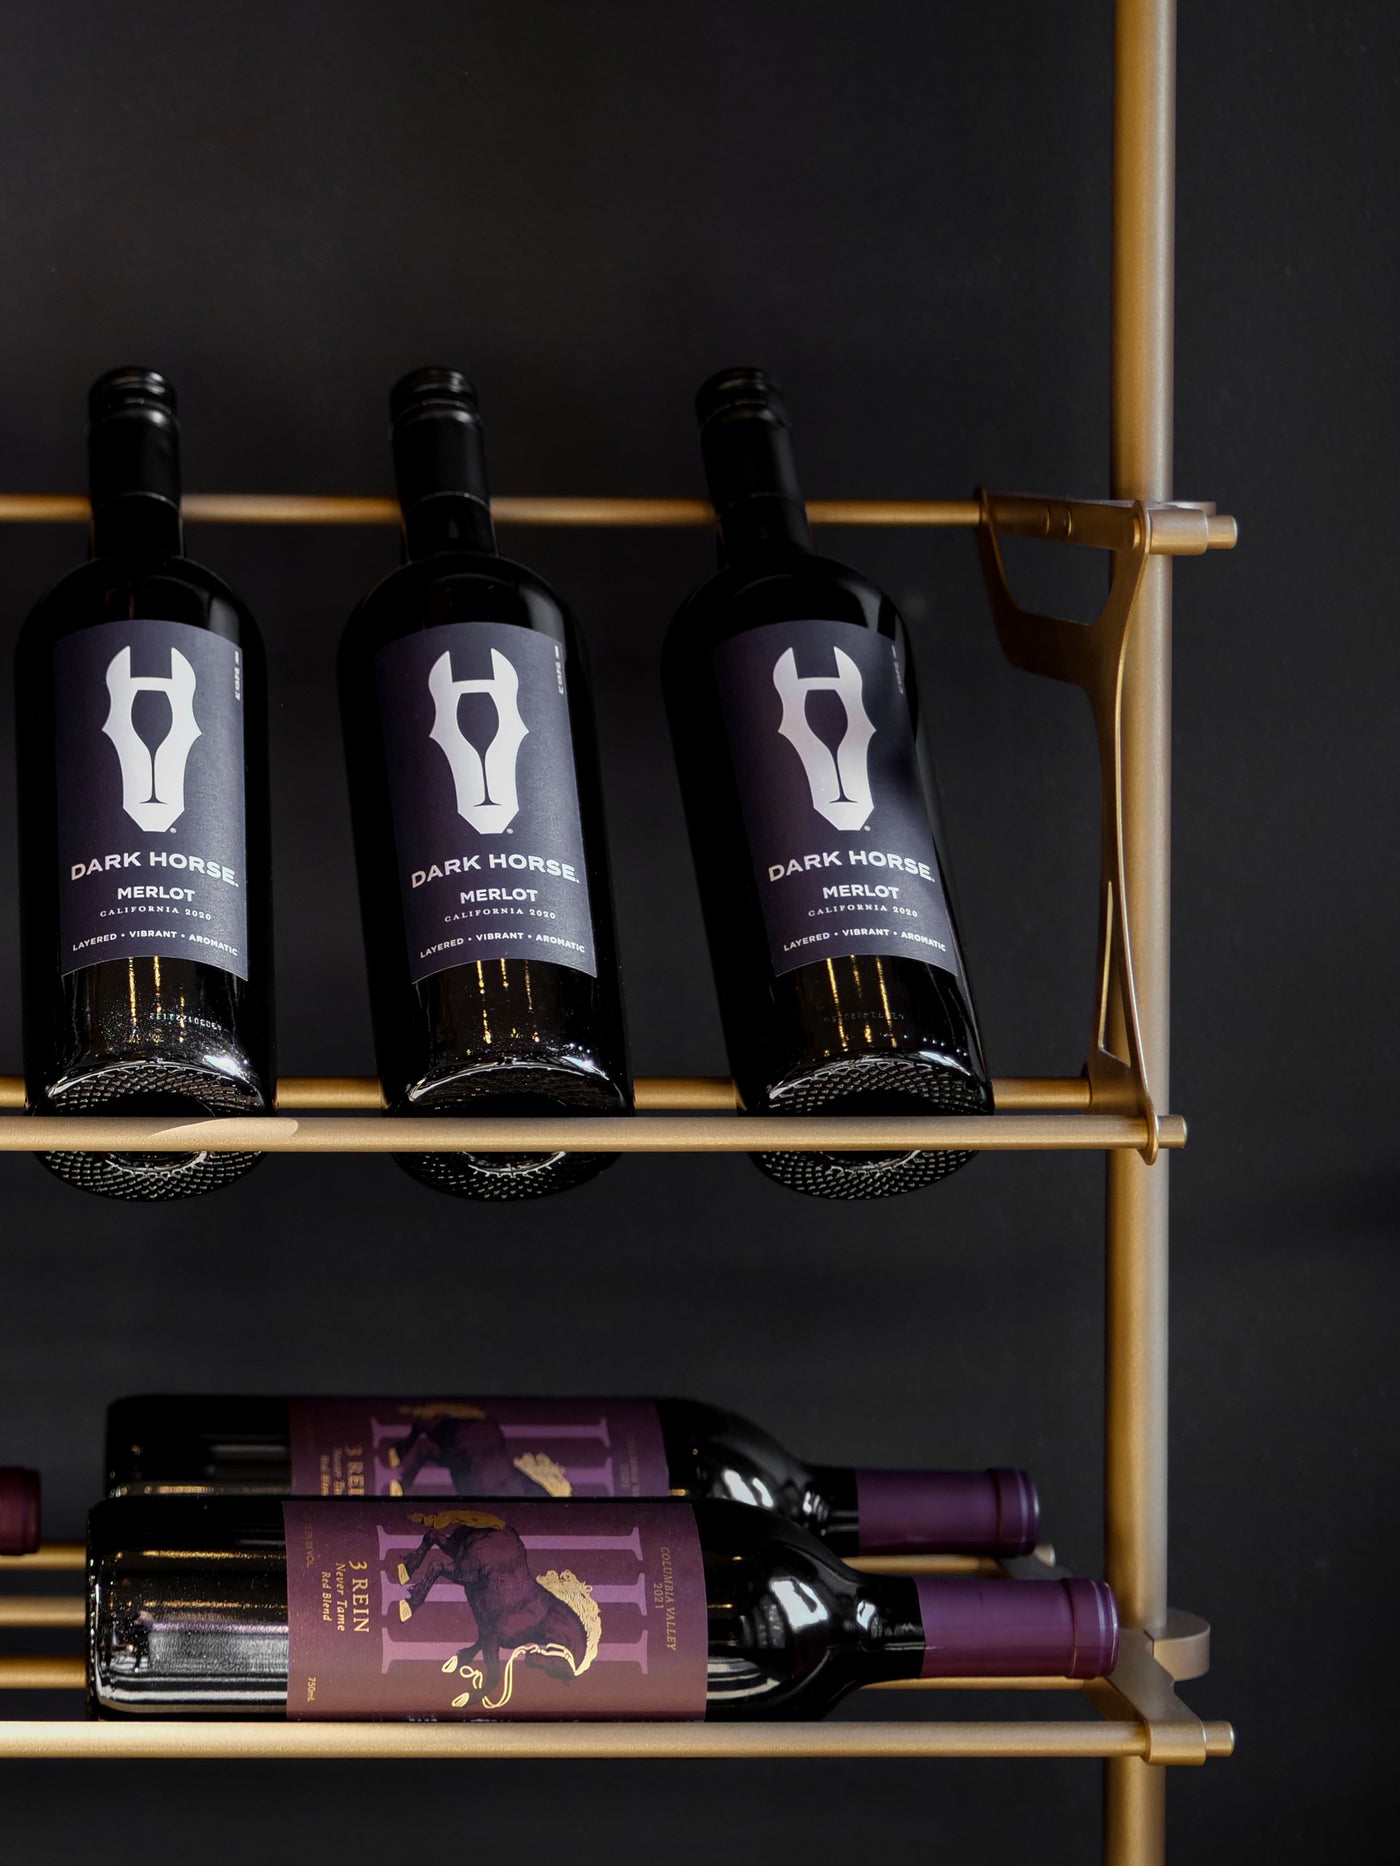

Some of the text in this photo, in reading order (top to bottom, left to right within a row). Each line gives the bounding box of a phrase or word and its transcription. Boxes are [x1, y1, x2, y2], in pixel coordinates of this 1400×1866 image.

[71, 852, 141, 881] DARK
[411, 855, 481, 888] DARK
[769, 851, 842, 882] DARK
[118, 887, 195, 902] MERLOT
[460, 889, 538, 903] MERLOT
[823, 884, 899, 899] MERLOT
[99, 906, 212, 920] CALIFORNIA 2020
[444, 908, 556, 922] CALIFORNIA 2020
[808, 904, 918, 917] CALIFORNIA 2020
[72, 929, 238, 956] LAYERED VIBRANT AROMATIC
[420, 932, 585, 958] LAYERED VIBRANT AROMATIC
[783, 928, 946, 952] LAYERED VIBRANT AROMATIC
[347, 1461, 365, 1497] REI
[322, 1571, 332, 1622] Red Blend
[336, 1562, 348, 1631] Never Tame
[349, 1560, 369, 1632] 3 REIN
[654, 1583, 664, 1609] 2021
[661, 1546, 676, 1651] COLUMBIA VALLEY
